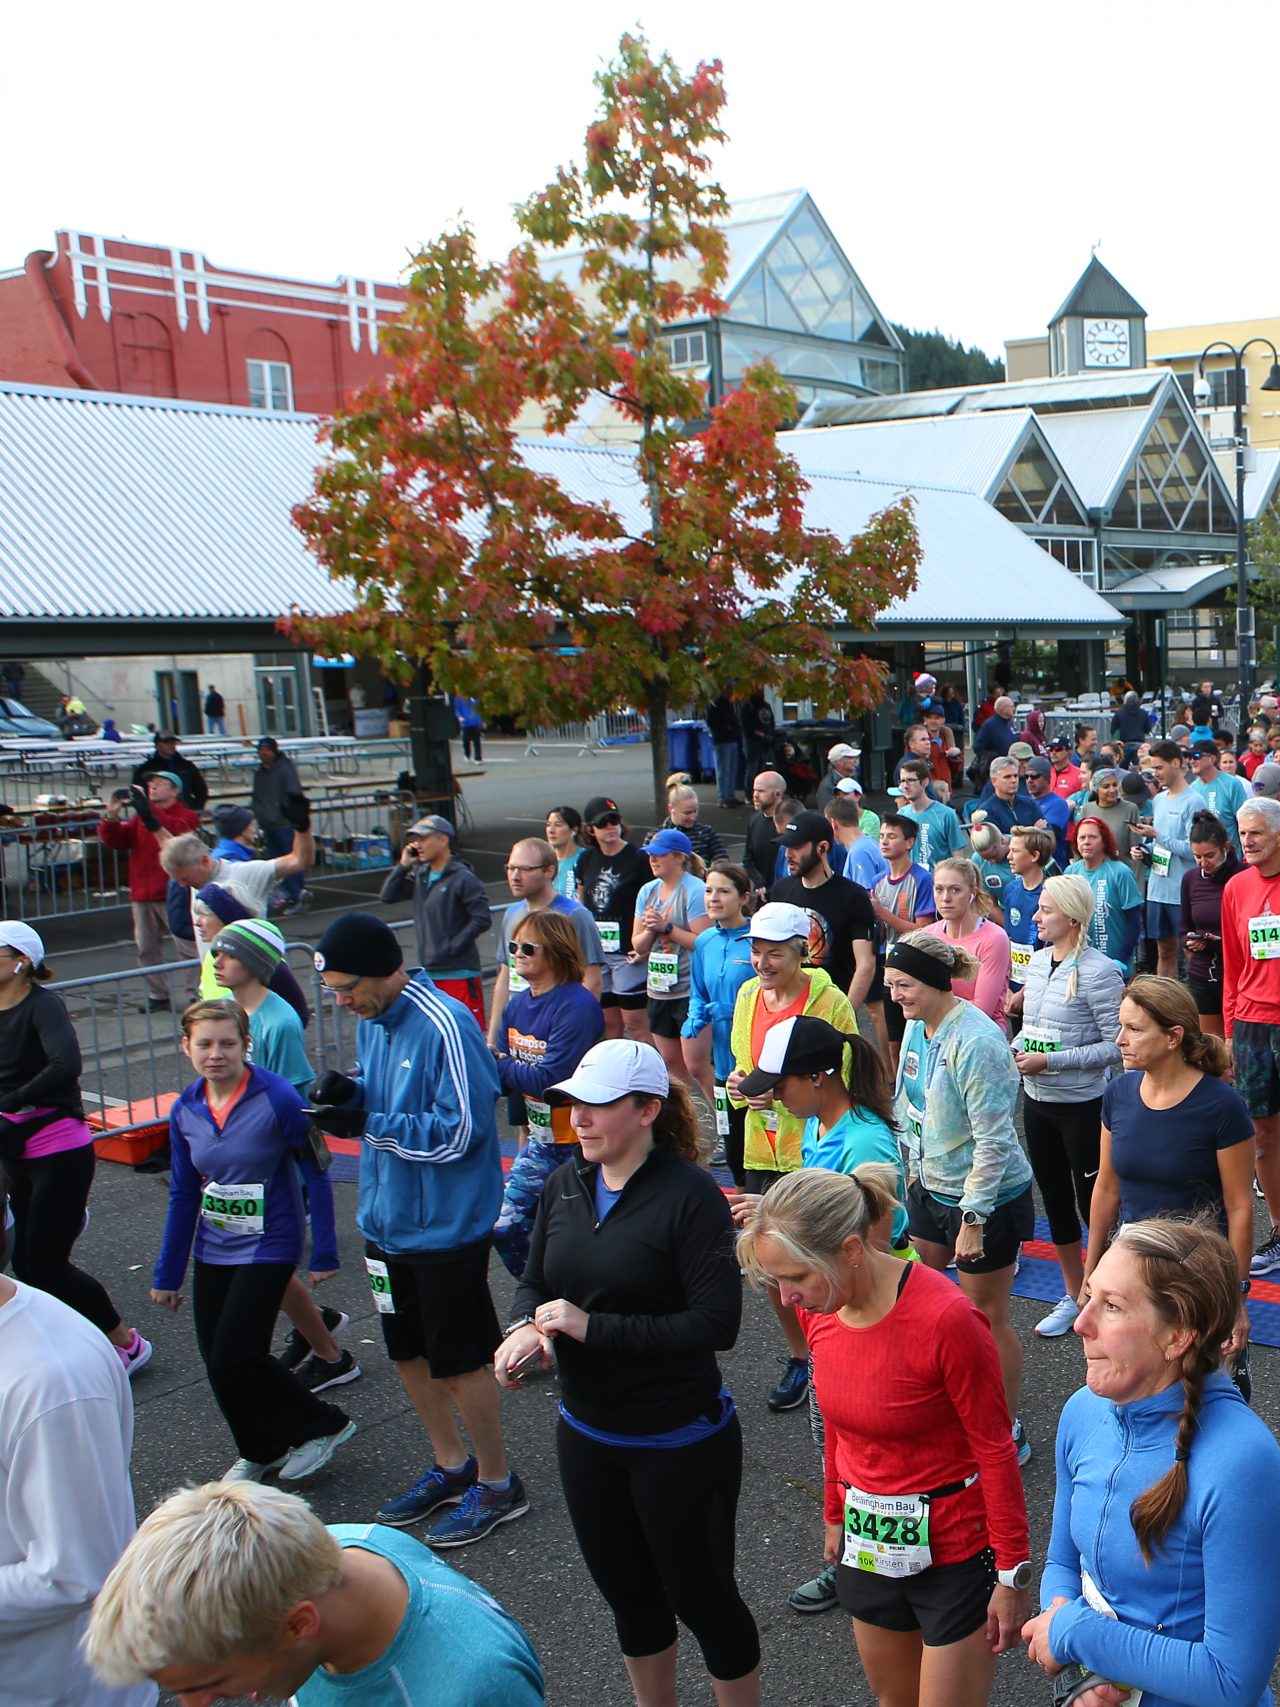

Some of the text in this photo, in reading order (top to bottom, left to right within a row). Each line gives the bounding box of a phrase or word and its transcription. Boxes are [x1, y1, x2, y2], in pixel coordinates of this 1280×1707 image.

[205, 1195, 257, 1216] 3360
[851, 1492, 915, 1513] Bellingham Bay
[848, 1508, 920, 1546] 3428
[859, 1557, 875, 1567] 10K
[875, 1556, 904, 1568] Kirsten
